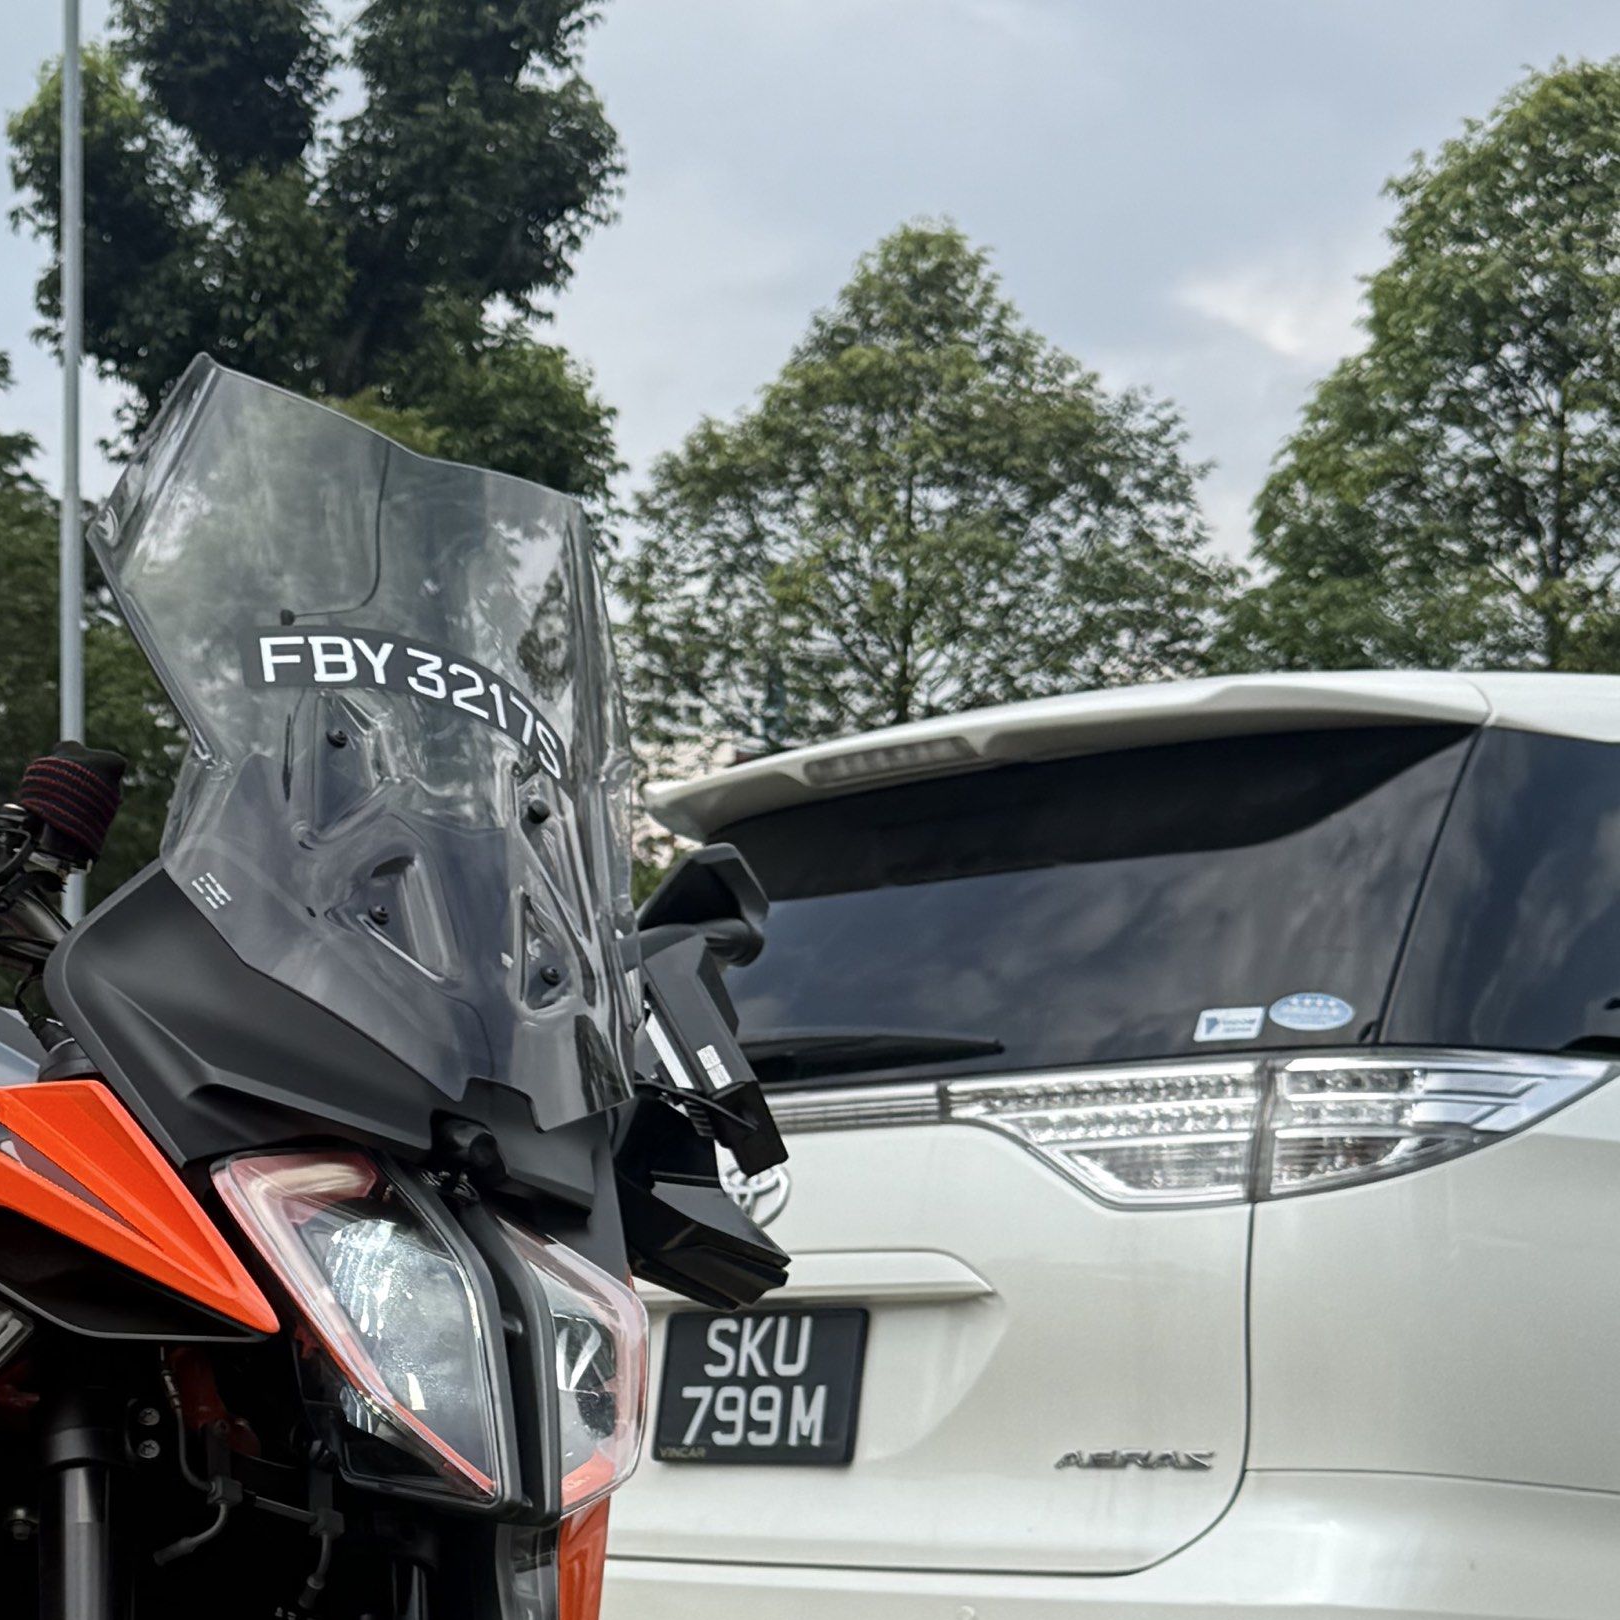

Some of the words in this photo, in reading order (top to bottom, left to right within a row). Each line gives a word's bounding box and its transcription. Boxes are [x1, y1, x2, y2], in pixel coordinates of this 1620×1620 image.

[259, 635, 394, 685] FBY
[406, 647, 561, 779] 3217S
[703, 1315, 813, 1378] SKU
[681, 1384, 828, 1447] 799M
